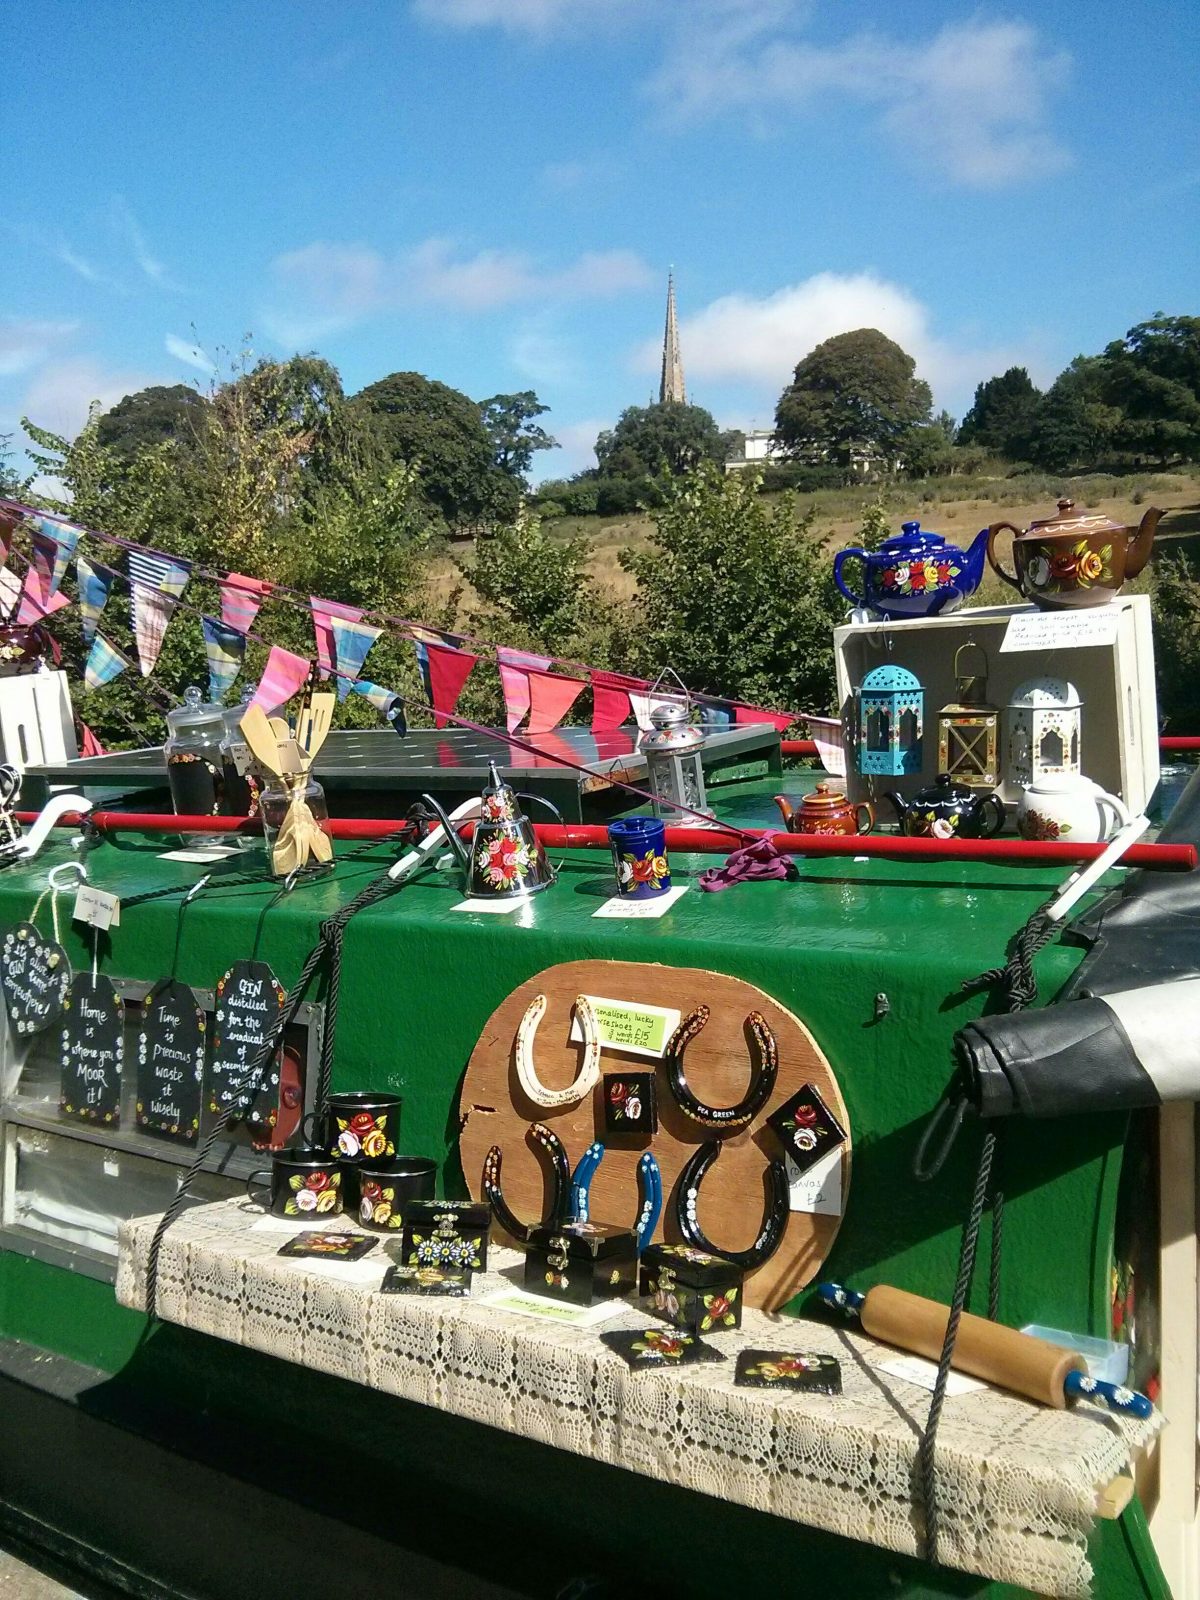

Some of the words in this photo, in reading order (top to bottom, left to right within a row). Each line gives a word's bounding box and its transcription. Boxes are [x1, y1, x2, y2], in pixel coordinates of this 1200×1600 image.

[8, 959, 25, 978] GIN
[239, 979, 263, 997] GIN
[4, 976, 51, 1019] somewhere!
[228, 994, 268, 1011] distilled
[80, 998, 108, 1025] Home
[158, 1005, 181, 1028] Time
[227, 1011, 243, 1028] for
[244, 1016, 262, 1032] the
[597, 1019, 632, 1031] rseshoes
[635, 1013, 654, 1028] lucky
[85, 1023, 94, 1038] is
[164, 1028, 174, 1043] is
[634, 1028, 651, 1041] £15
[226, 1031, 274, 1048] eradicat
[71, 1040, 98, 1060] where
[98, 1050, 114, 1068] you
[237, 1045, 247, 1060] of
[76, 1063, 108, 1088] MOOR
[155, 1066, 184, 1083] waste
[87, 1087, 102, 1106] it!
[162, 1082, 173, 1096] it
[697, 1105, 709, 1116] PEA
[712, 1110, 735, 1118] GREEN
